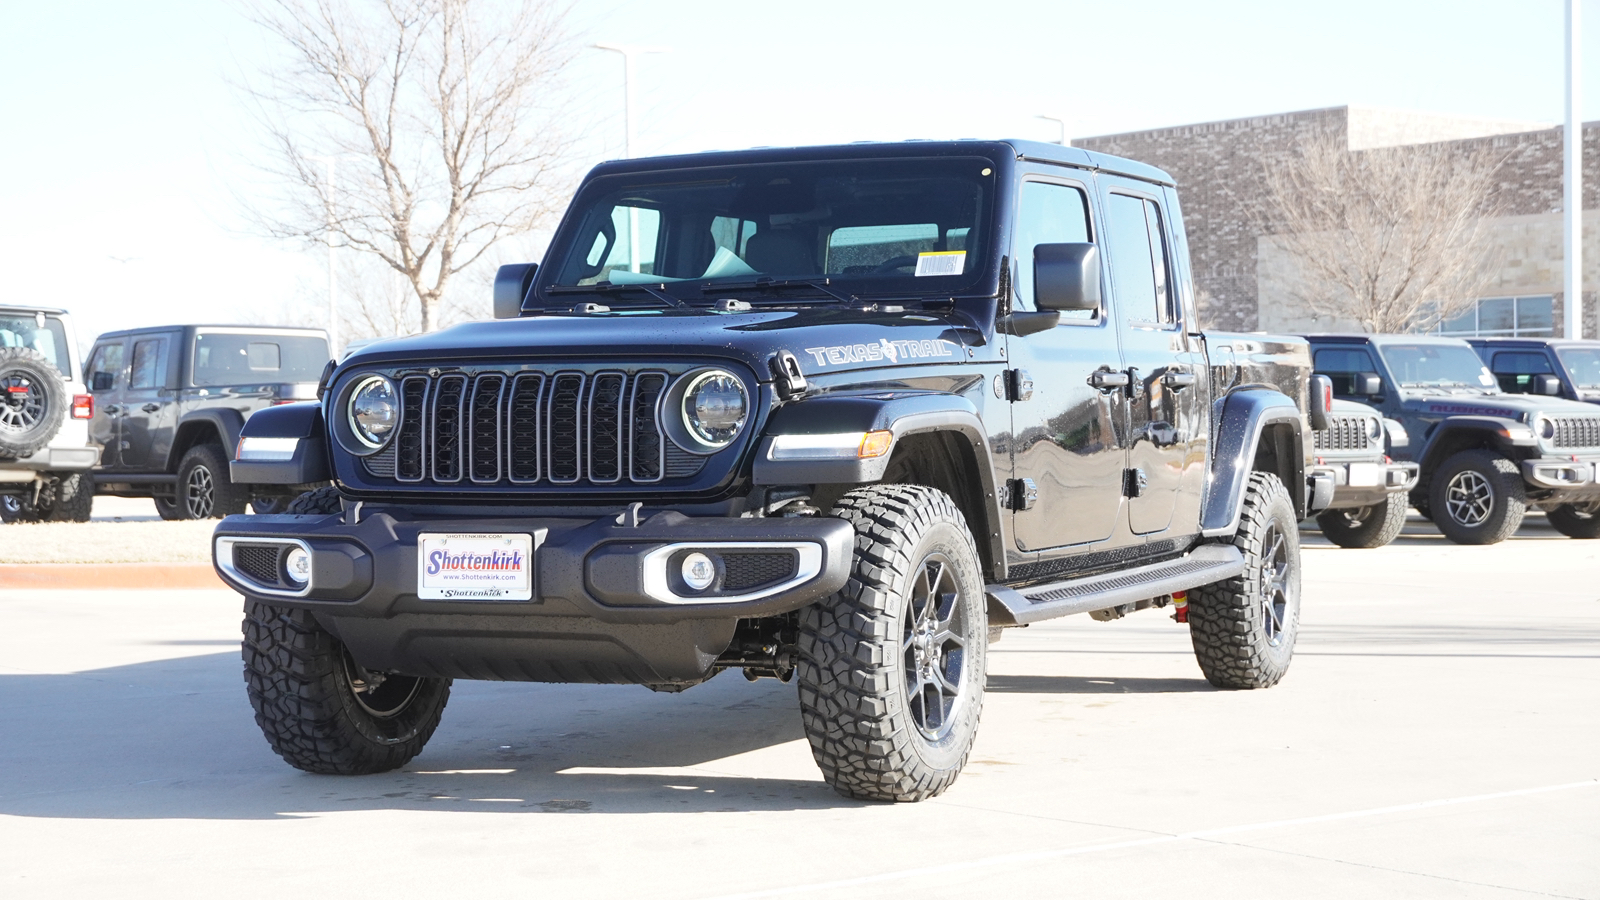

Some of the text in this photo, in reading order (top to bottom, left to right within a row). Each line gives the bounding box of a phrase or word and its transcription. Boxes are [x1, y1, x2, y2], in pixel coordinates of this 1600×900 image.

[805, 339, 952, 366] TEXAS TRAIL
[1429, 404, 1513, 416] RUBICON
[427, 549, 522, 575] Shottenkirk
[444, 589, 502, 598] Shottenkirk
